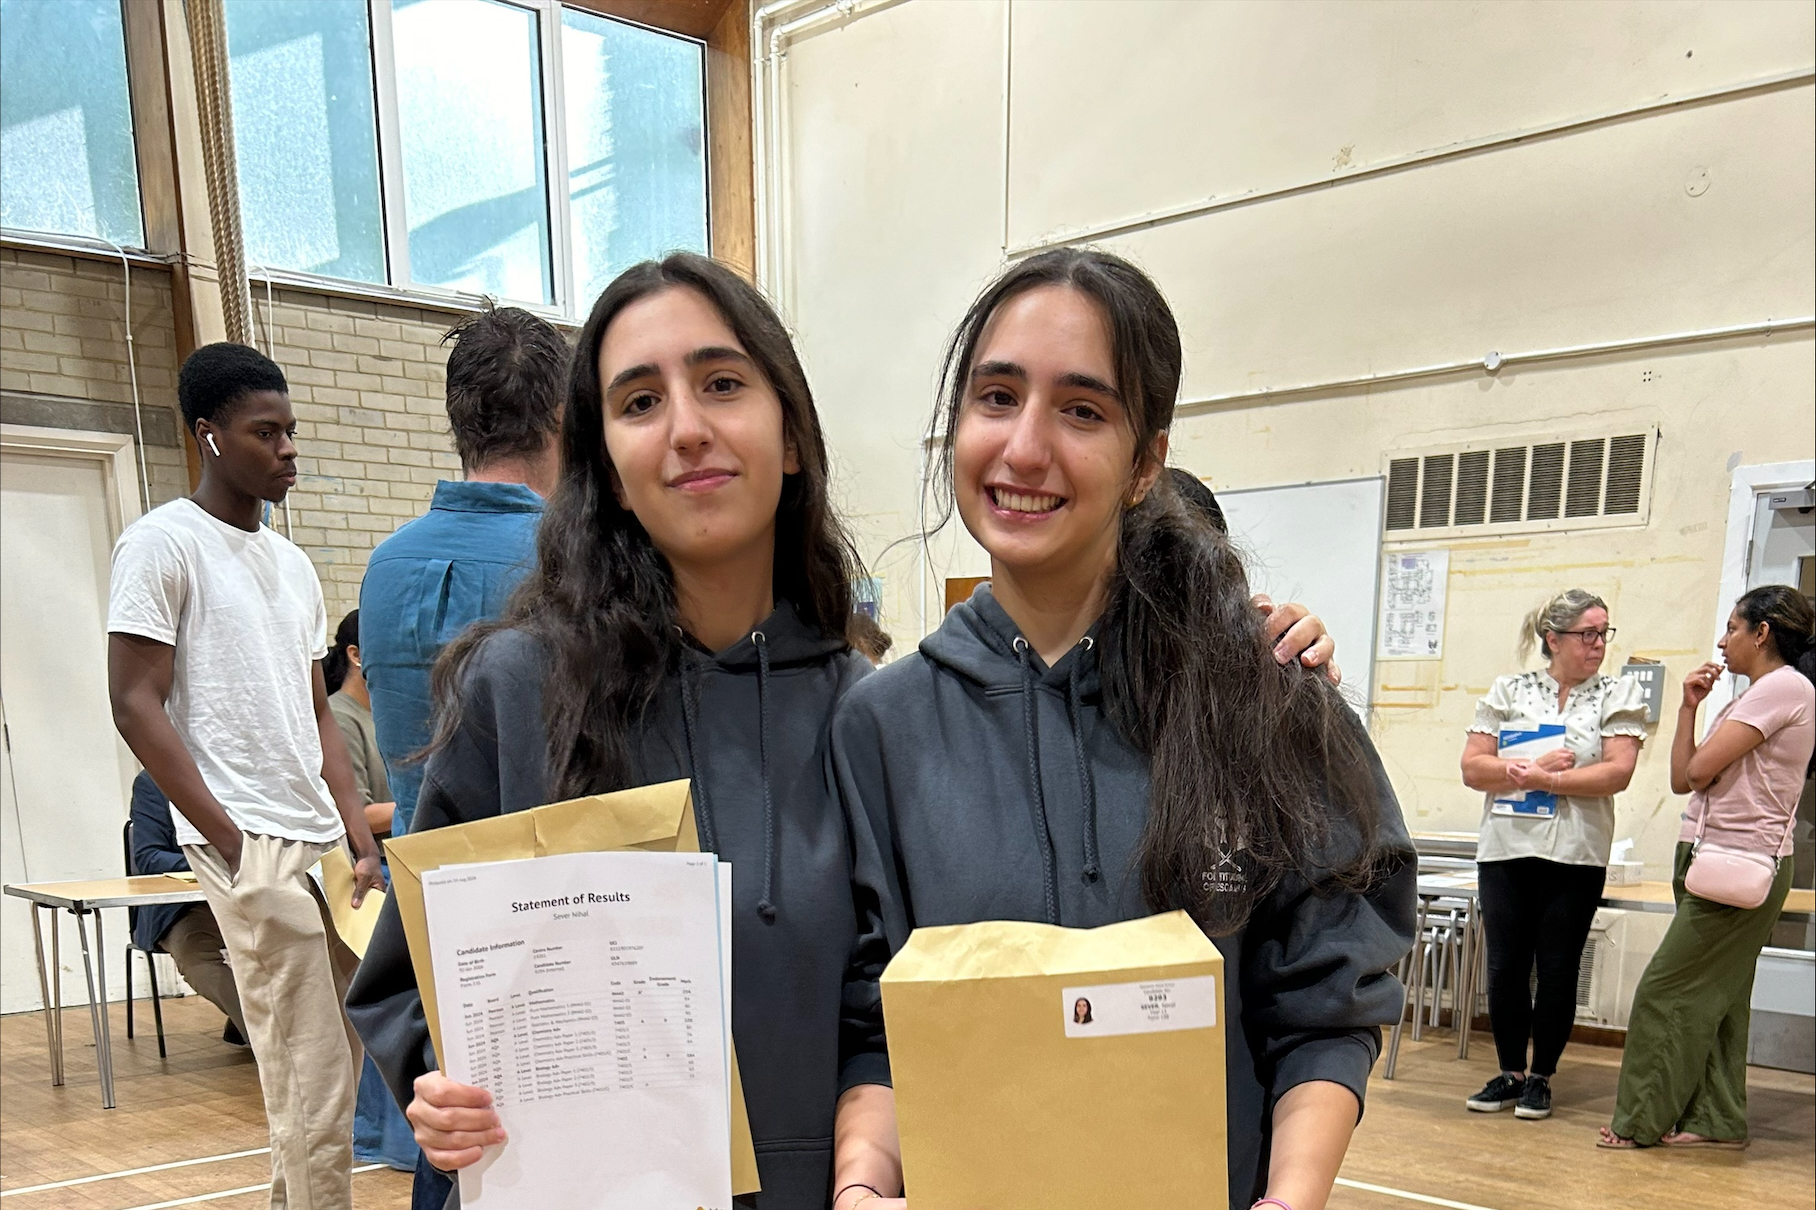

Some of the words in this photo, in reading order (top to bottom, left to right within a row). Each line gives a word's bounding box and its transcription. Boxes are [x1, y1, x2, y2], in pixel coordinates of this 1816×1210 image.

[512, 896, 569, 913] Statement
[573, 894, 585, 904] of
[588, 892, 631, 903] Results
[572, 910, 589, 918] Nihal
[457, 945, 489, 956] Candidate
[490, 939, 525, 951] Information
